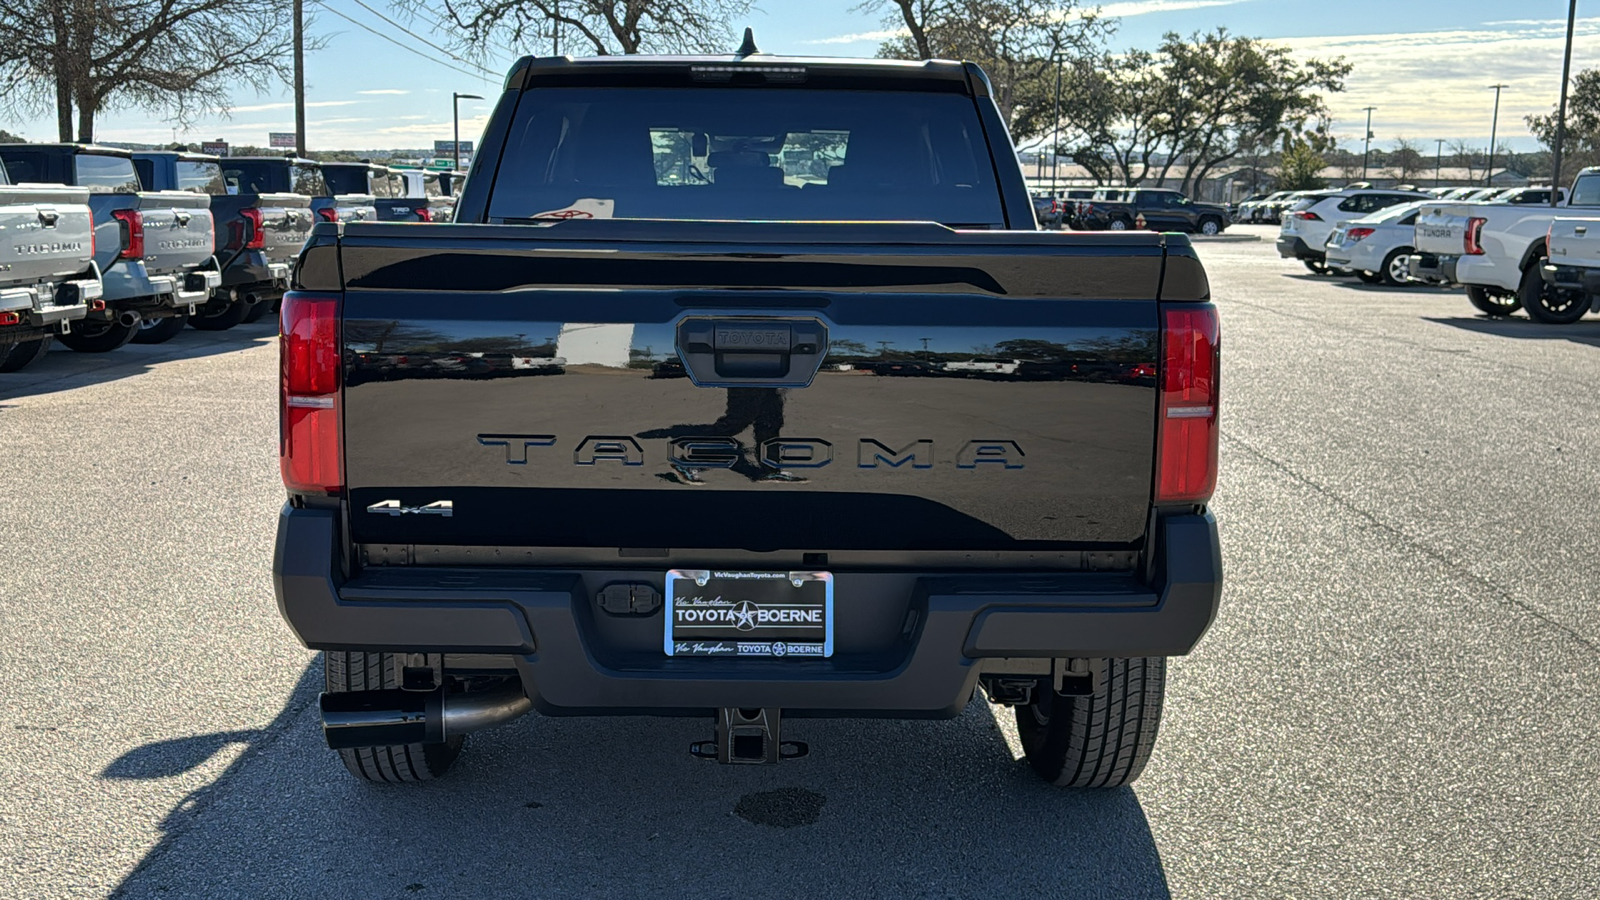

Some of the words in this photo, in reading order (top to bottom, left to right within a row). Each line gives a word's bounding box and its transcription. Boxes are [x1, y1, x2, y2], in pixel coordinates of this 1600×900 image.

[1422, 228, 1452, 239] TUNDRA
[14, 242, 82, 256] TACOMA
[718, 331, 788, 345] TOYOTA
[476, 433, 1026, 470] TACOMA
[366, 499, 454, 517] 4x4
[713, 571, 786, 580] VicVaughanToyota.com
[674, 596, 690, 606] Vic
[692, 596, 732, 607] Vaughan
[675, 609, 736, 622] TOYOTA
[757, 609, 823, 622] BOERNE
[674, 642, 691, 653] Vic
[692, 642, 734, 654] Vaughan
[737, 645, 772, 653] TOYOTA
[787, 645, 823, 654] BOERNE
